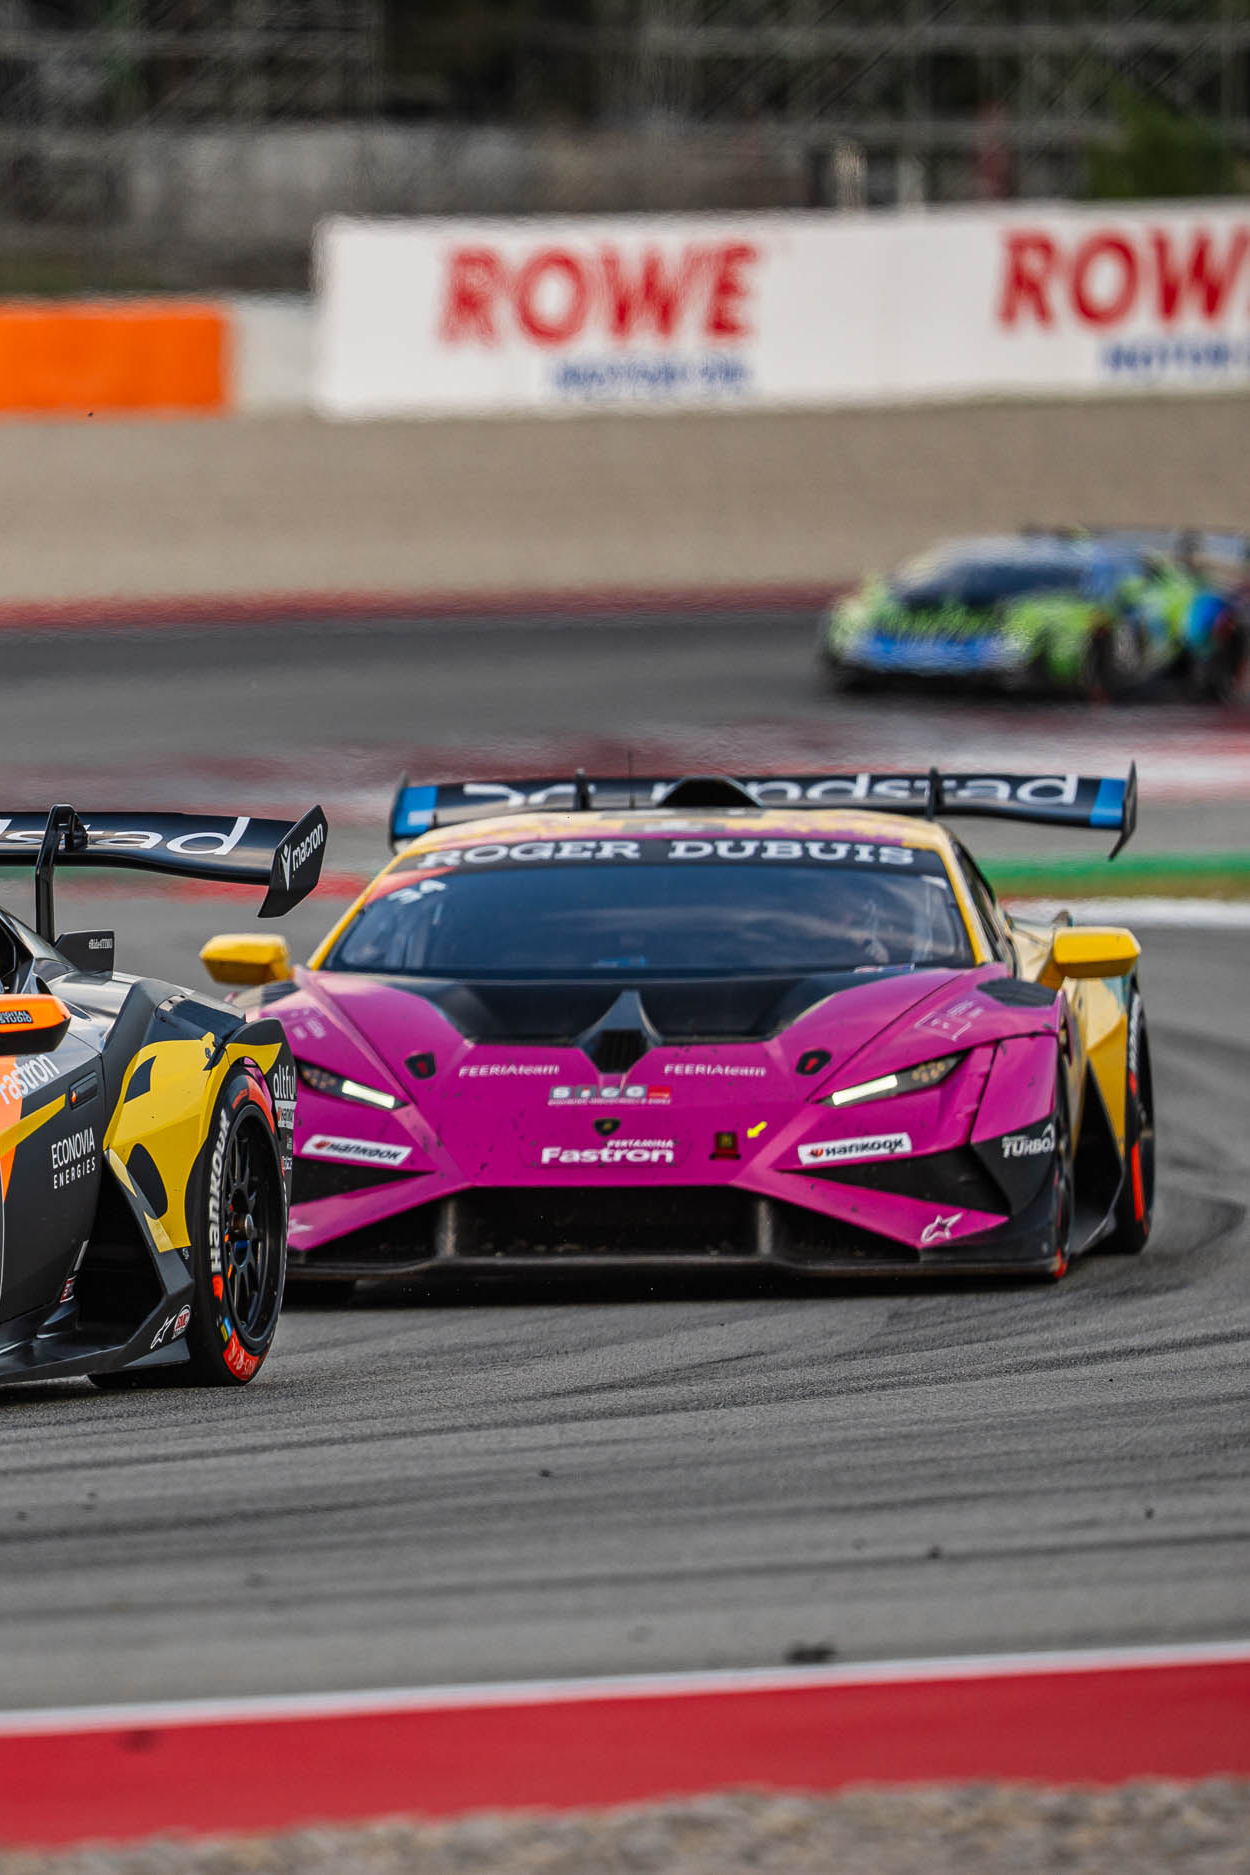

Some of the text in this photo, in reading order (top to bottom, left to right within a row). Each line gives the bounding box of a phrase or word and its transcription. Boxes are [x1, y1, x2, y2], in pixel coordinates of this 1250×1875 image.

[438, 244, 756, 350] ROWE
[998, 230, 1250, 332] ROW
[291, 823, 324, 872] macron
[417, 840, 915, 868] ROGER DUBUIS
[51, 1127, 96, 1170] ECONOVIA
[540, 1147, 674, 1164] Fastron
[53, 1156, 96, 1190] ENERGIES
